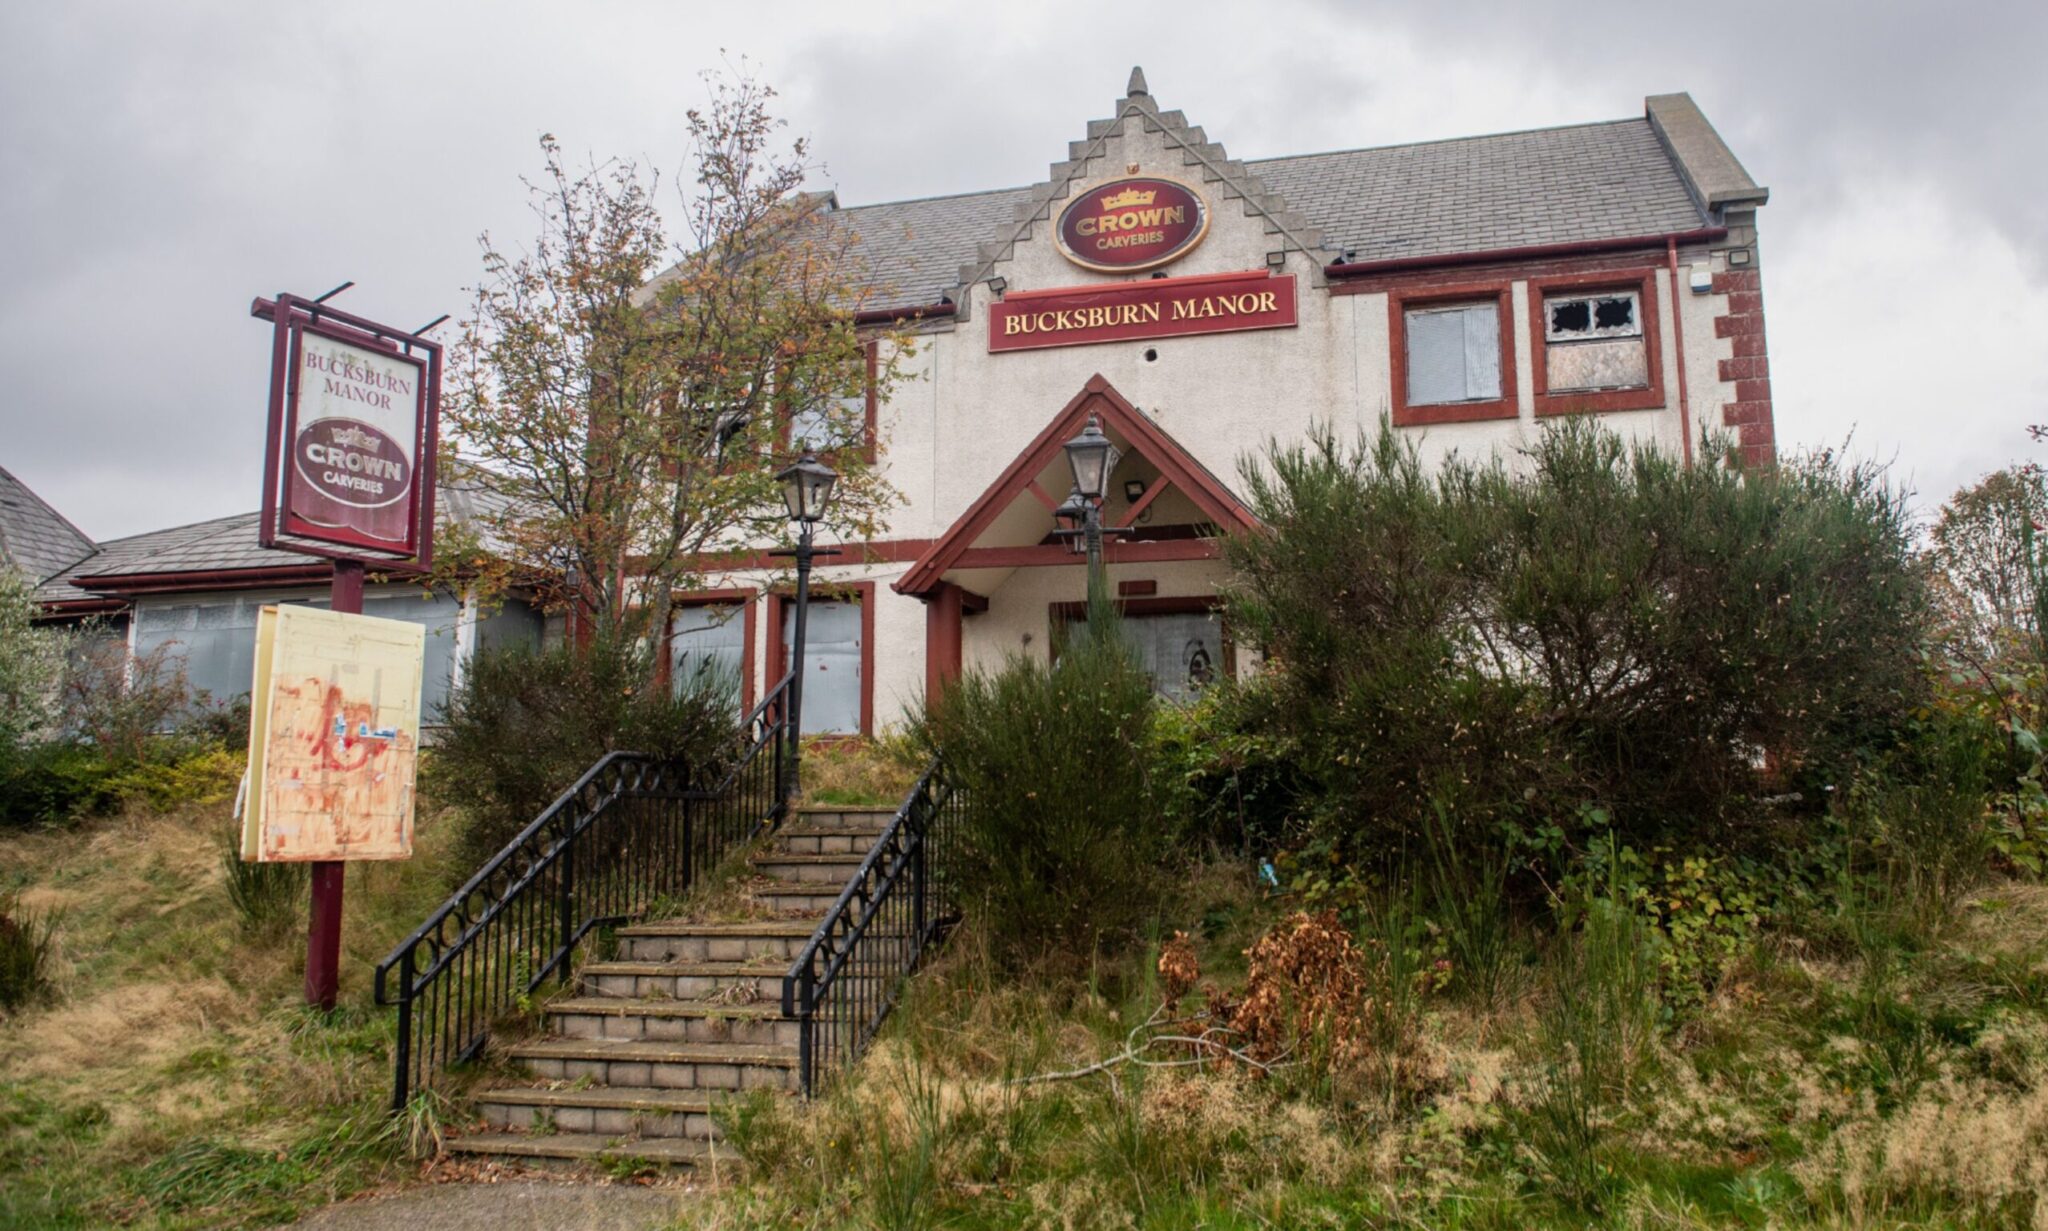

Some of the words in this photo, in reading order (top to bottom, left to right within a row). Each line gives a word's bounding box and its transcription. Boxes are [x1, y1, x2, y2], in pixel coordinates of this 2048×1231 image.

[1075, 205, 1185, 236] CROWN
[1096, 231, 1164, 250] CARVERIES
[1004, 302, 1161, 336] BUCKSBURN
[1171, 292, 1278, 321] MANOR
[306, 352, 411, 396] BUCKSBURN
[323, 378, 391, 410] MANOR
[306, 443, 402, 482] CROWN
[323, 470, 384, 495] CARVERIES
